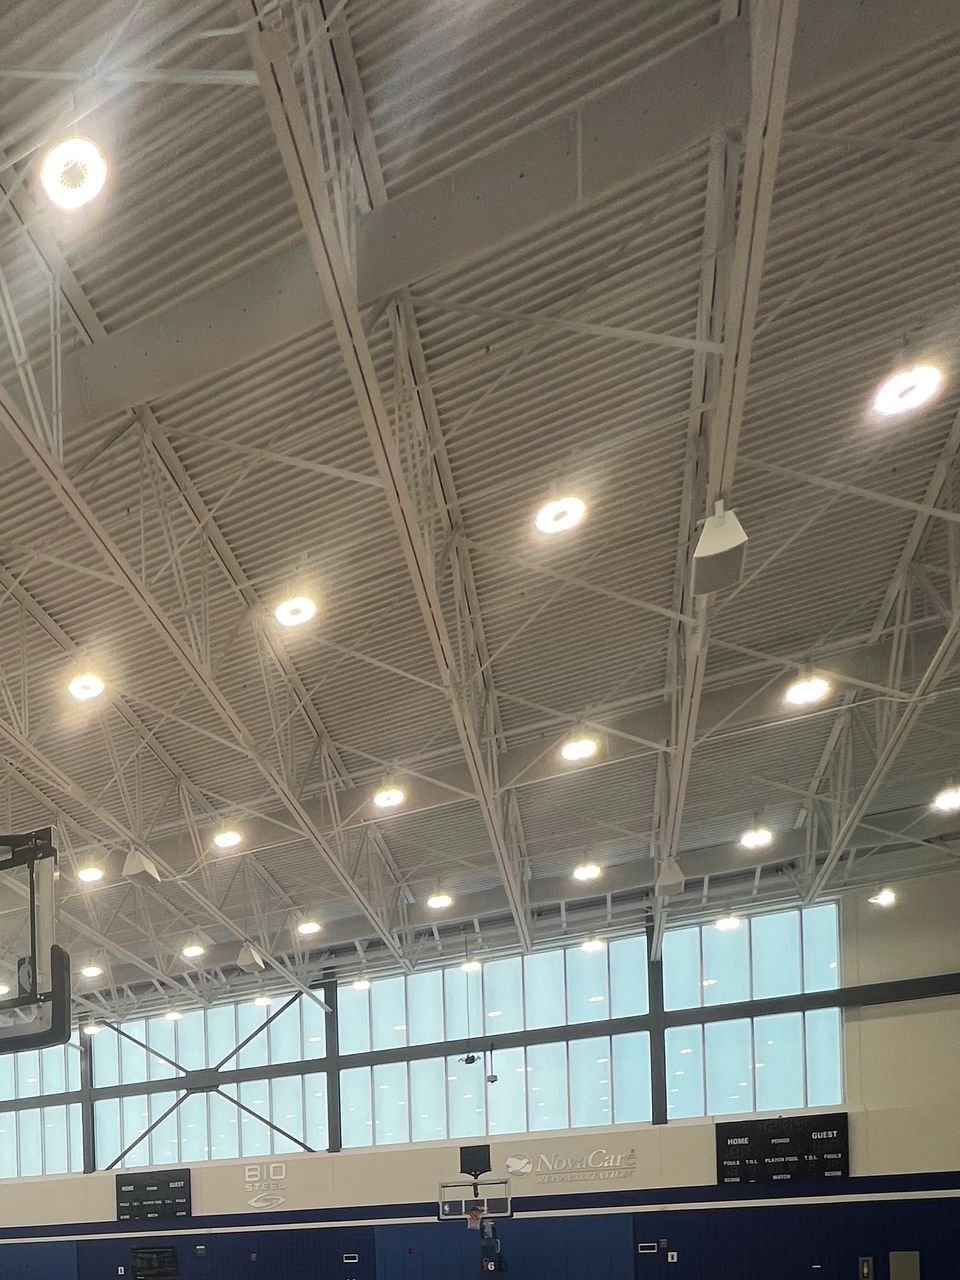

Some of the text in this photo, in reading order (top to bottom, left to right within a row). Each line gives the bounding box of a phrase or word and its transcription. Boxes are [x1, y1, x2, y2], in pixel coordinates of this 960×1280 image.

[812, 1130, 838, 1139] GUEST
[727, 1137, 749, 1145] HOME
[245, 1163, 286, 1181] BIO
[245, 1182, 287, 1192] STEEL
